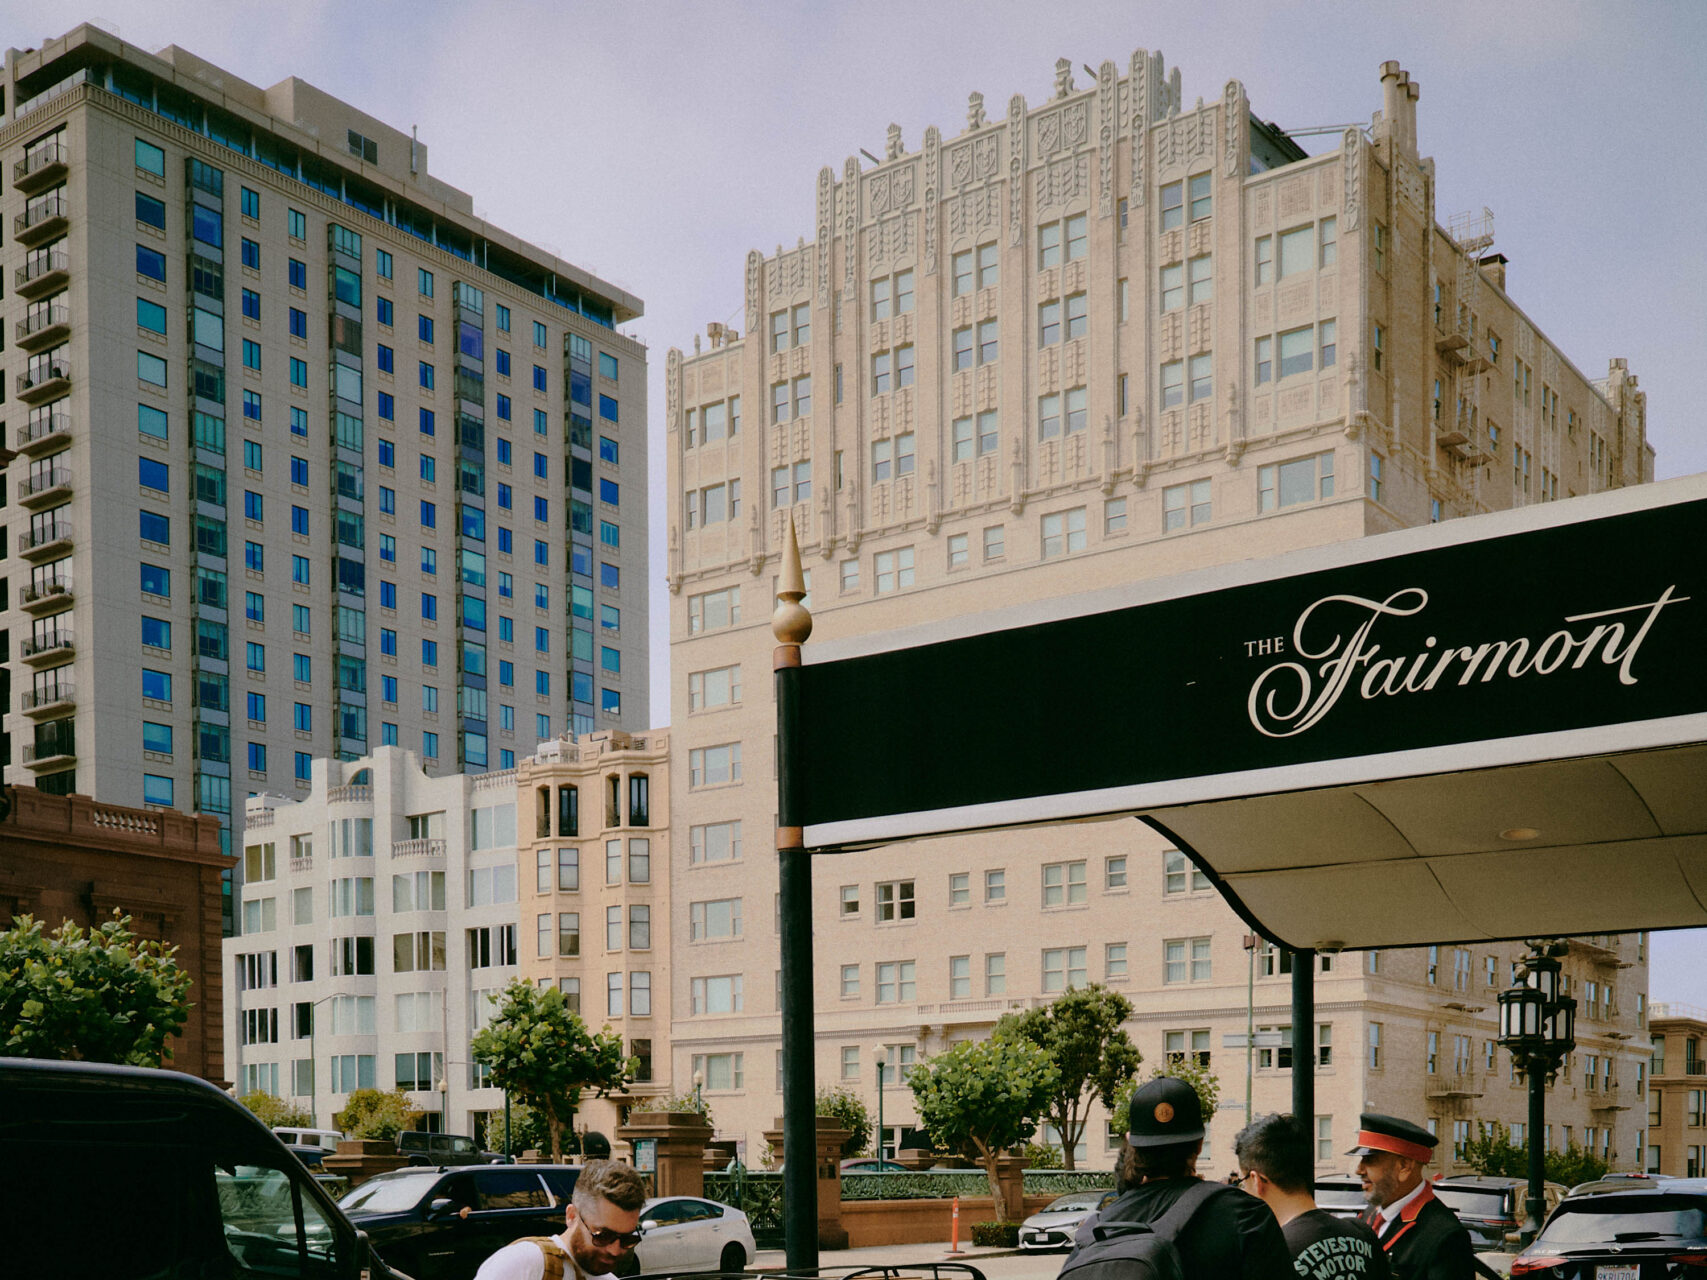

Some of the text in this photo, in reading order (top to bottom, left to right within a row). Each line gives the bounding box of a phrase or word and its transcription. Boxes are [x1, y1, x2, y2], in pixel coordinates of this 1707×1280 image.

[1244, 584, 1691, 738] THE Fairmont
[1293, 1236, 1373, 1277] STEVESTON
